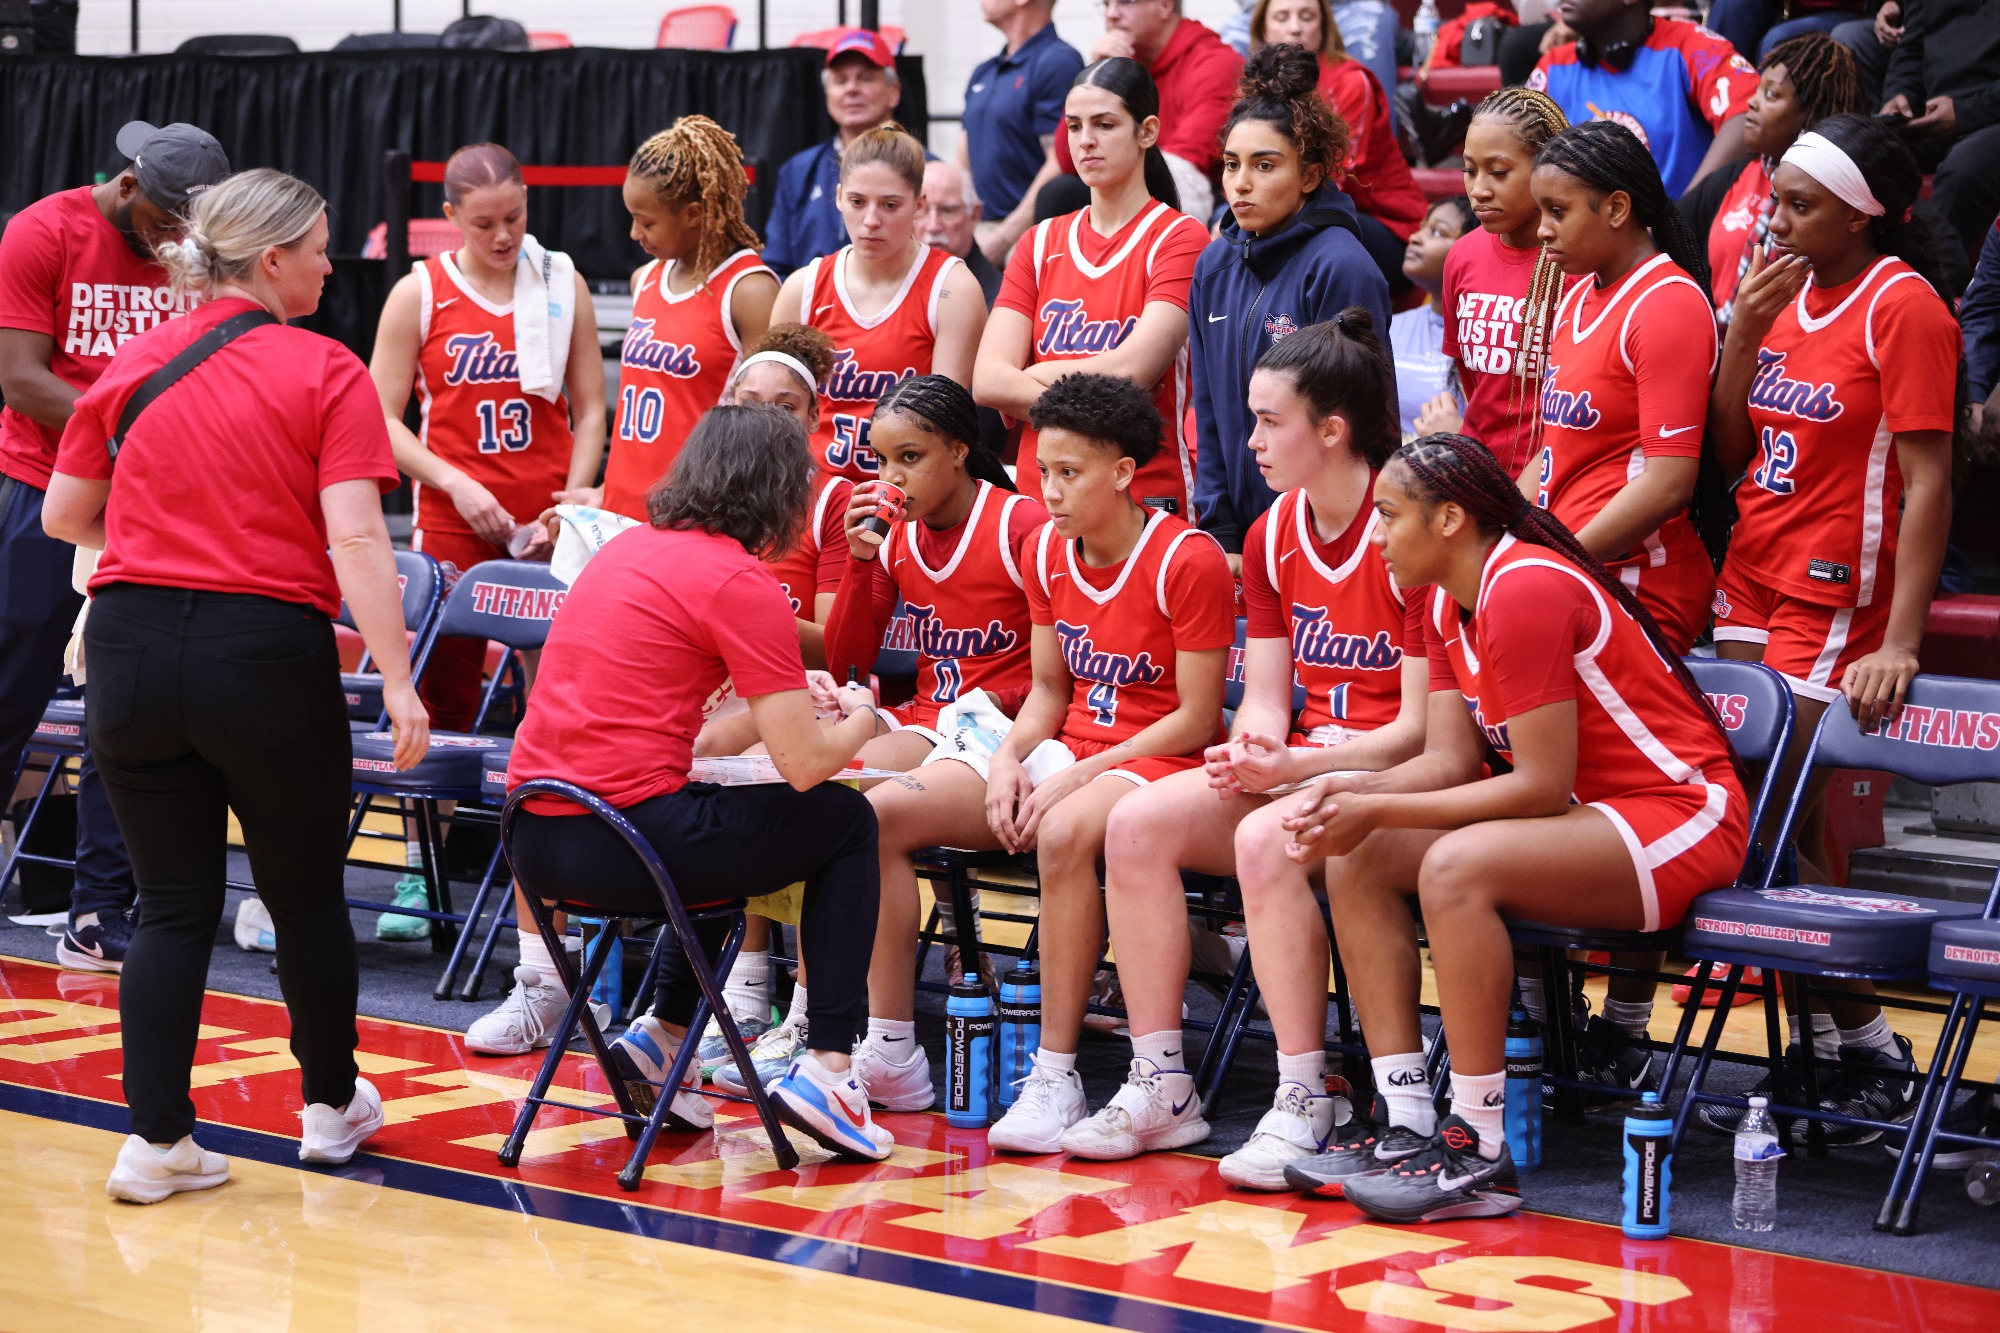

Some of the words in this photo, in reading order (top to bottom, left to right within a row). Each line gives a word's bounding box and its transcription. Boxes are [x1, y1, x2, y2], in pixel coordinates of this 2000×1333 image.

[1456, 292, 1547, 327] DETROI
[443, 331, 520, 387] Tita
[1458, 318, 1545, 351] USTLE
[817, 348, 916, 402] itan
[1460, 344, 1551, 379] ARDE
[620, 384, 665, 443] 10
[1541, 363, 1601, 431] tans
[476, 399, 532, 454] 13
[825, 413, 879, 474] 55
[1753, 425, 1798, 496] 12
[471, 581, 569, 621] TITANS
[904, 601, 1016, 660] Titans
[1054, 619, 1164, 688] Titans
[1292, 602, 1404, 671] Titans
[932, 658, 963, 703] 0
[1328, 681, 1353, 720] 1
[1087, 683, 1119, 728] 4
[373, 760, 397, 773] TEAM
[1858, 783, 1866, 795] A
[1695, 917, 1745, 935] DETROITS
[1747, 923, 1796, 942] COLLEGE
[1797, 930, 1831, 946] TEAM
[1944, 945, 2000, 965] DETROITS
[1001, 1007, 1041, 1017] POWERADE
[954, 1017, 965, 1108] POWERADE
[1643, 1141, 1655, 1218] POWERADE
